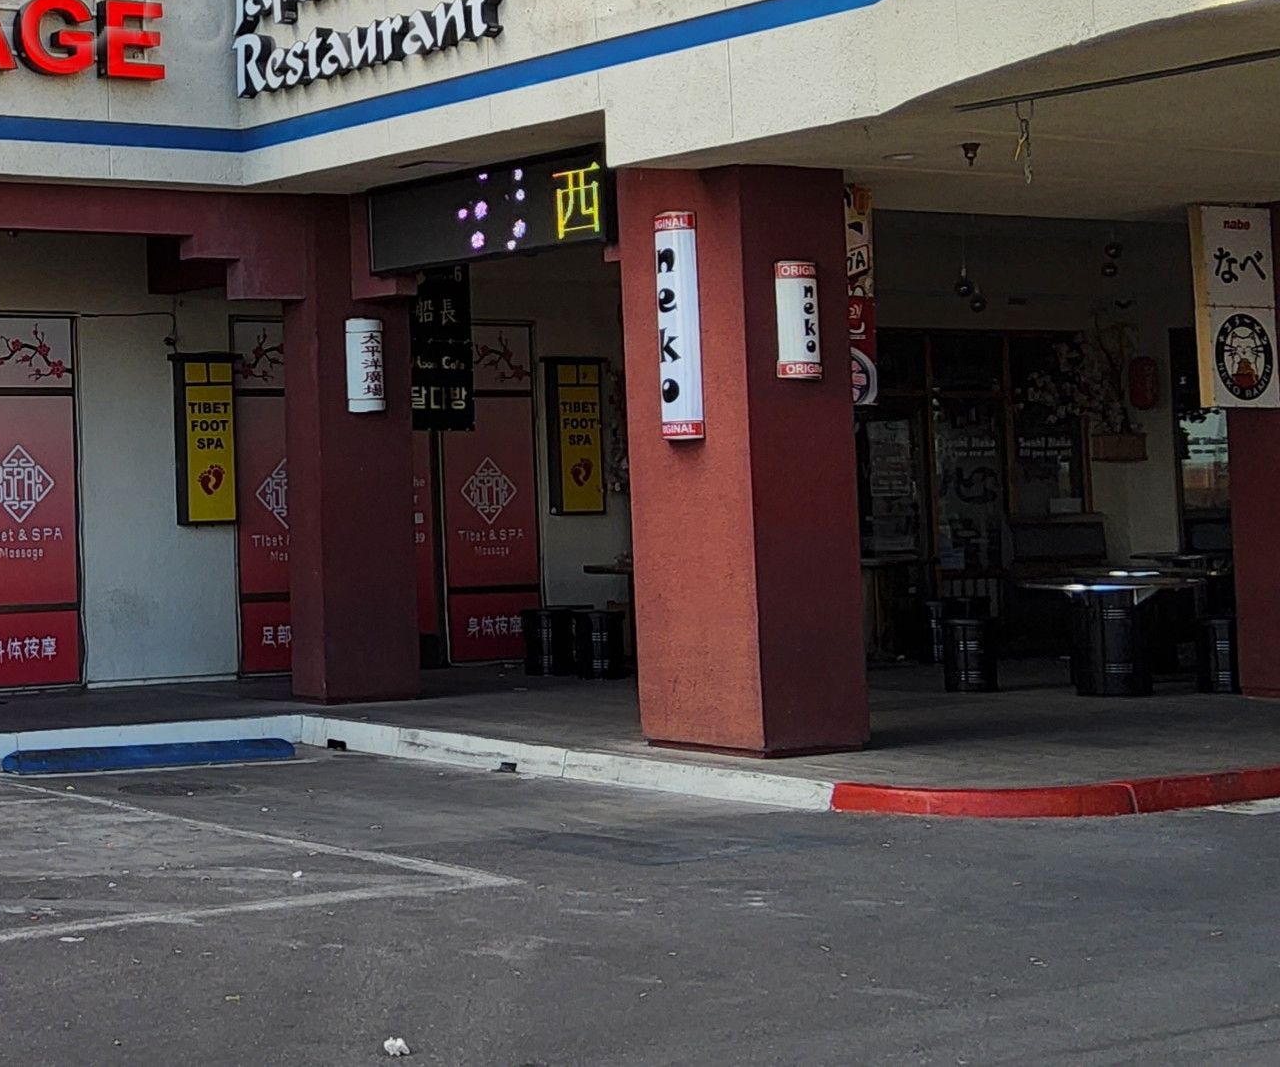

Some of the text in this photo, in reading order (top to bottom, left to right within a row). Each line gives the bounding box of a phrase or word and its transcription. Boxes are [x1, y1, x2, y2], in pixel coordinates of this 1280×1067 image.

[552, 162, 600, 239] 西
[1224, 219, 1251, 230] nabe
[1214, 247, 1266, 283] なべ
[416, 298, 457, 326] 船長
[803, 285, 816, 353] neko
[657, 247, 681, 403] neko
[361, 333, 381, 396] 太平洋廣場
[188, 402, 230, 414] TIBET
[560, 401, 597, 413] TIBET
[191, 419, 229, 432] FOOT
[563, 418, 597, 429] FOOT
[197, 437, 224, 450] SPA
[568, 434, 592, 446] SPA
[19, 528, 28, 541] &
[31, 527, 63, 542] SPA
[0, 547, 44, 561] Massage
